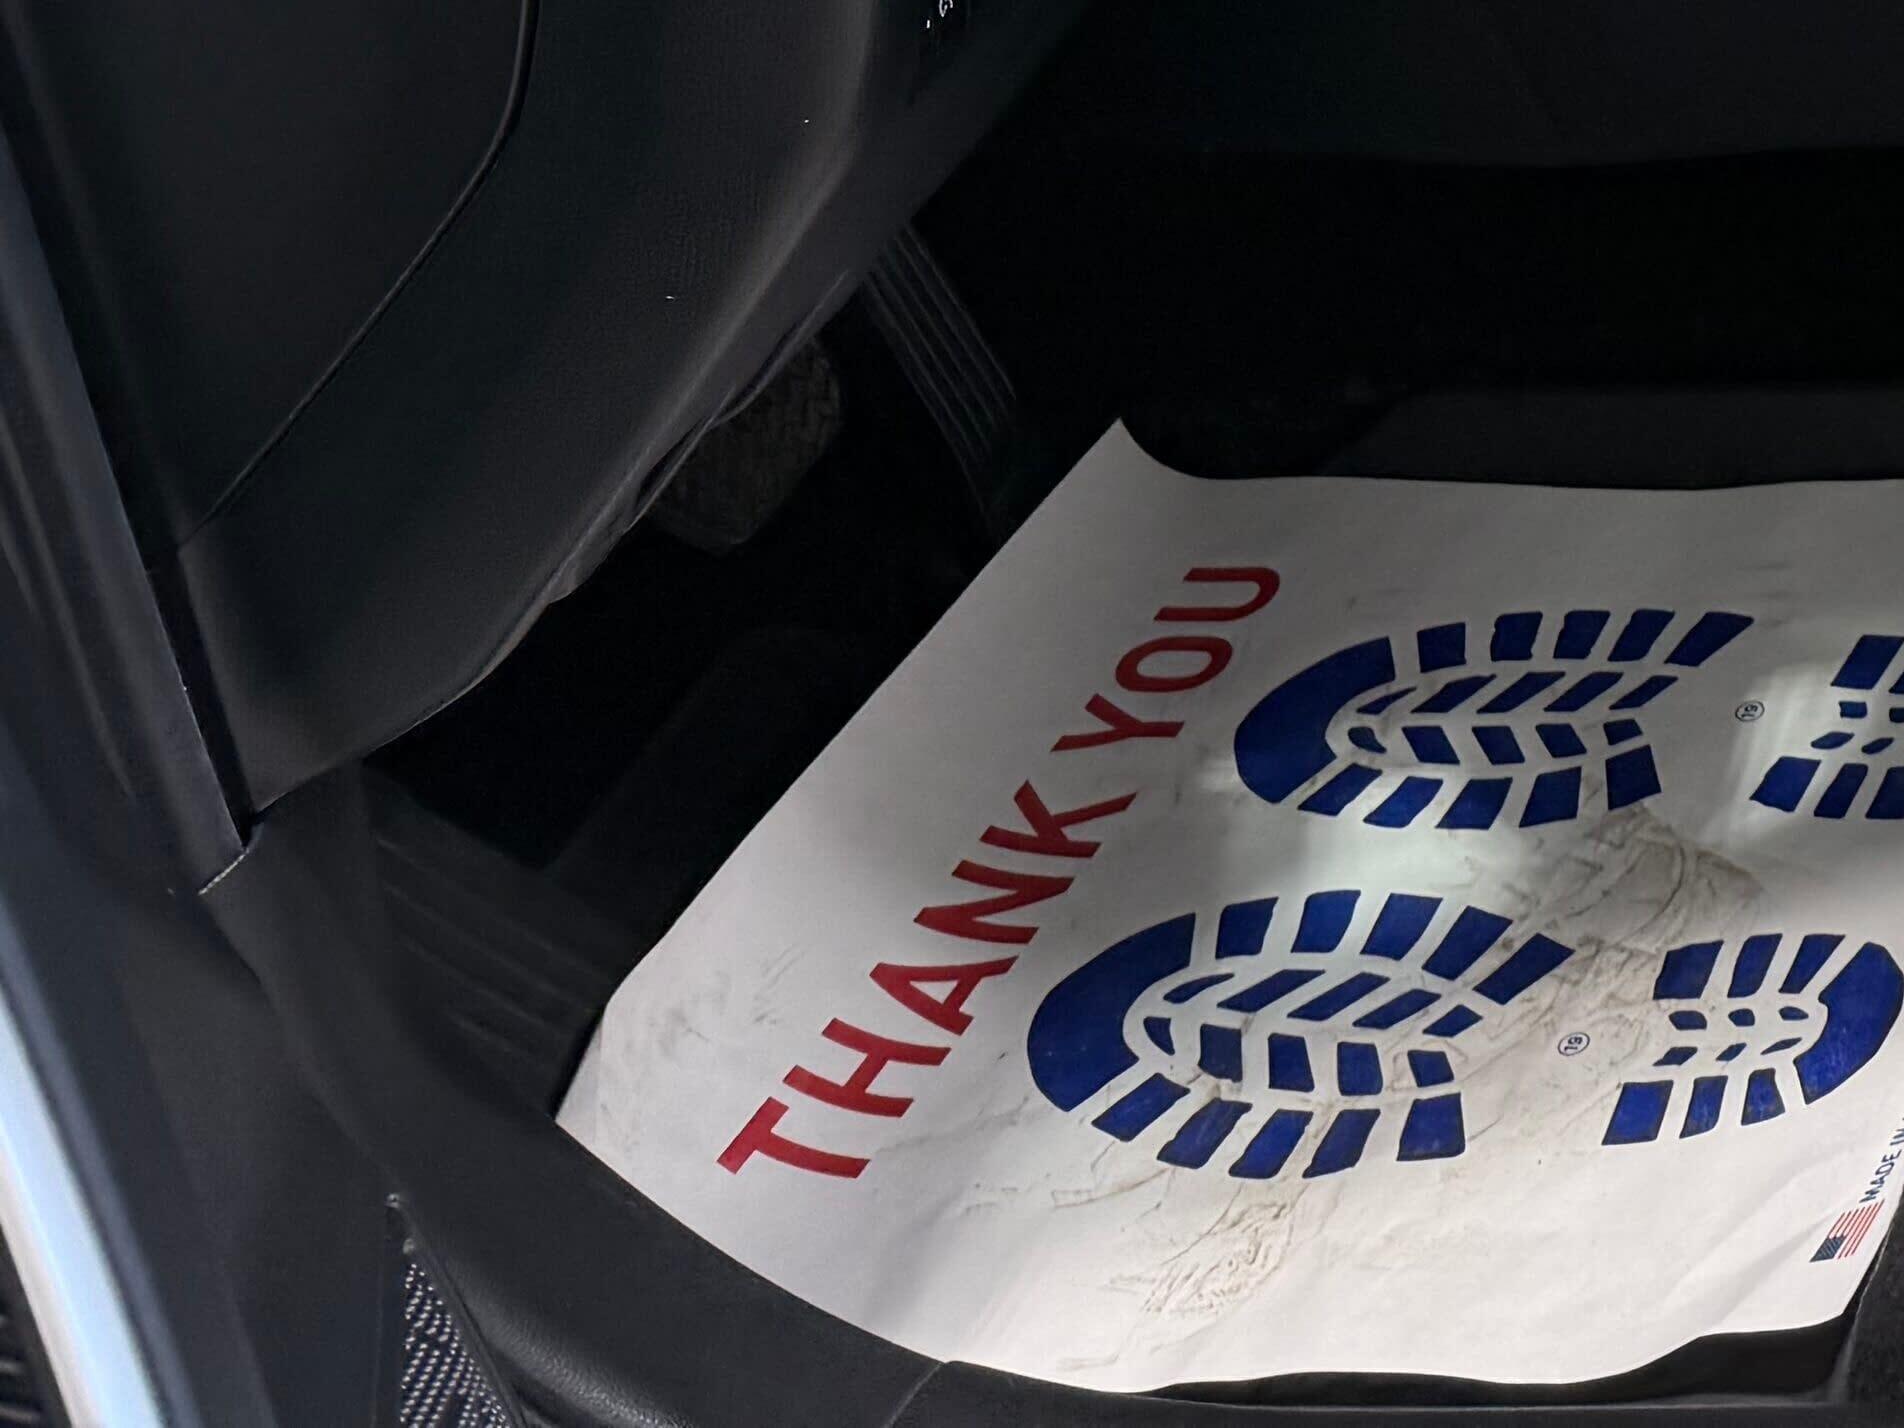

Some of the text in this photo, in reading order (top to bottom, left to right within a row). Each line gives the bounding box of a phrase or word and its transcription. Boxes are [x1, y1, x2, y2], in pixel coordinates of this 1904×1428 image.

[716, 566, 1280, 1179] THANK YOU
[1859, 1149, 1902, 1204] MADE
